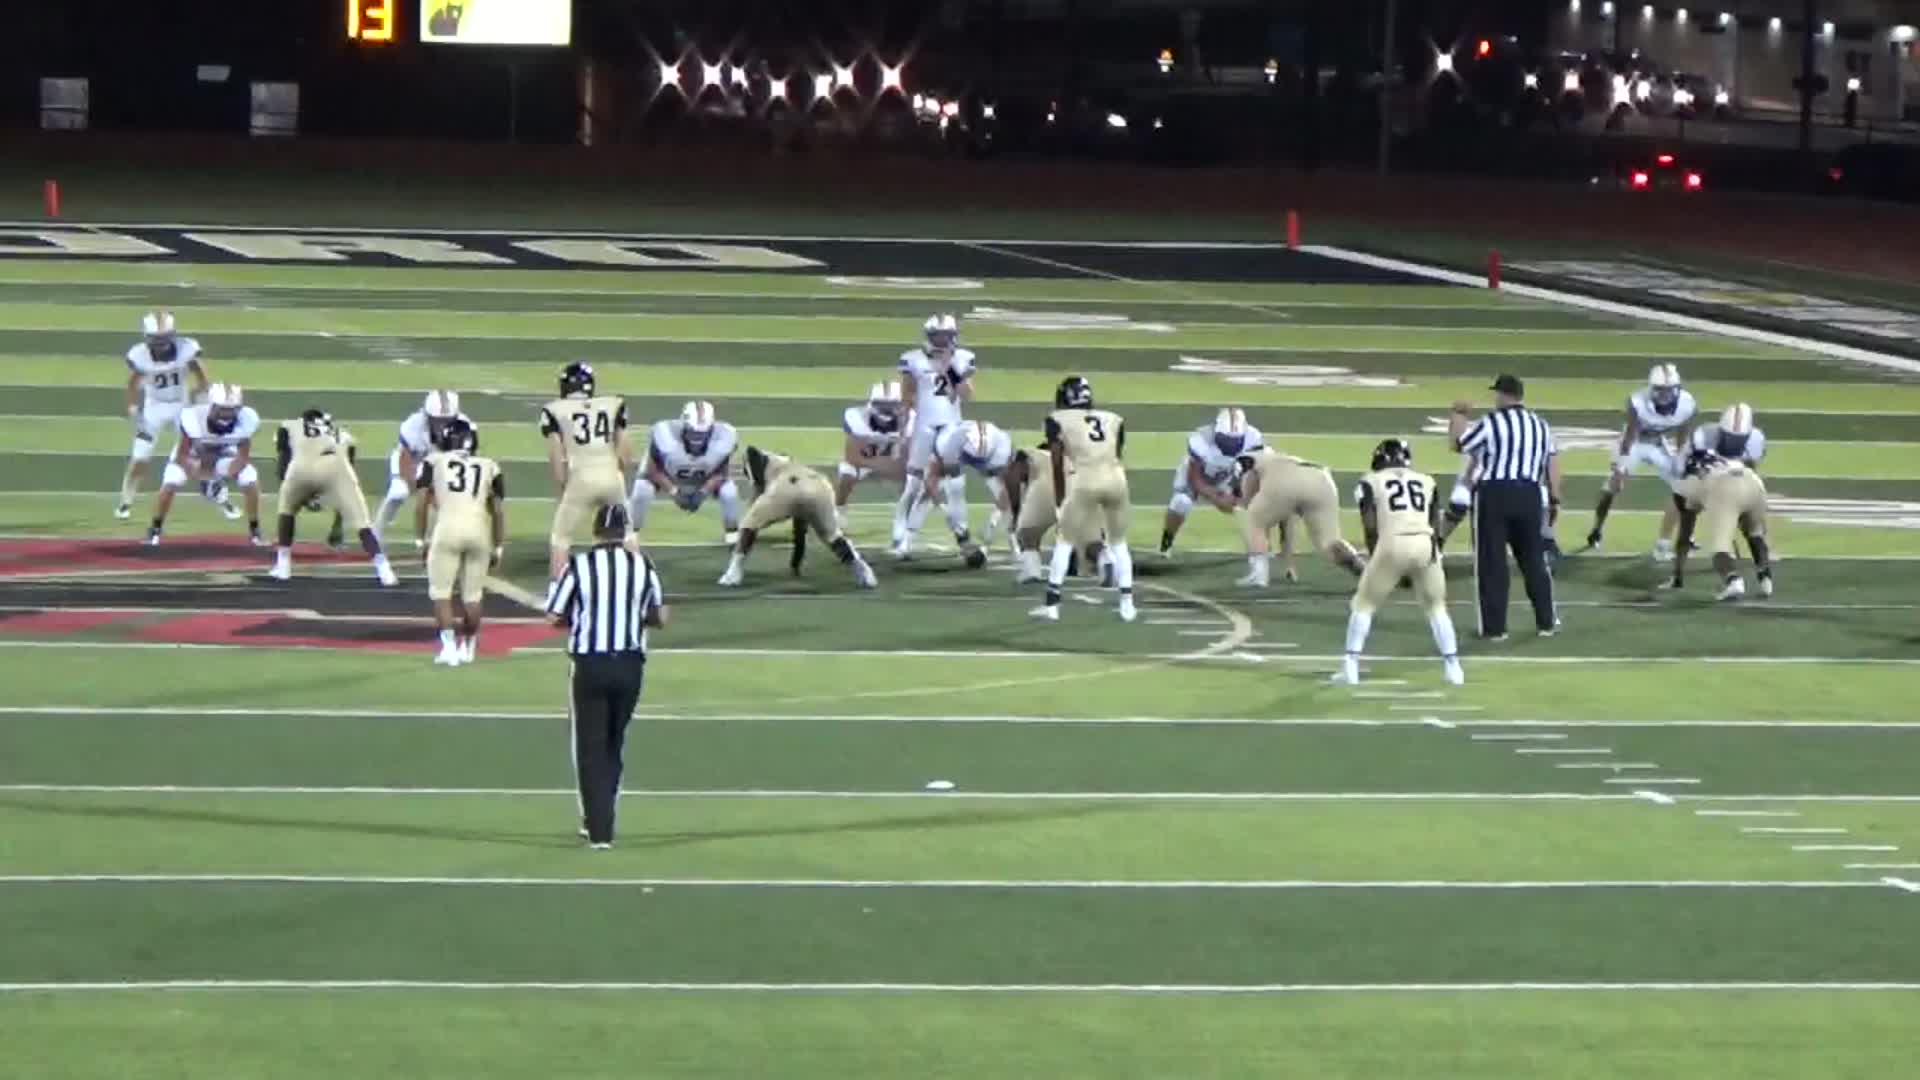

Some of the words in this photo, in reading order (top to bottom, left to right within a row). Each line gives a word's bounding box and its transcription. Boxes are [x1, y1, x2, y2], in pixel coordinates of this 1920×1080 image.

[572, 409, 610, 445] 34
[1084, 415, 1105, 442] 3
[448, 460, 481, 497] 31
[1385, 479, 1425, 512] 26
